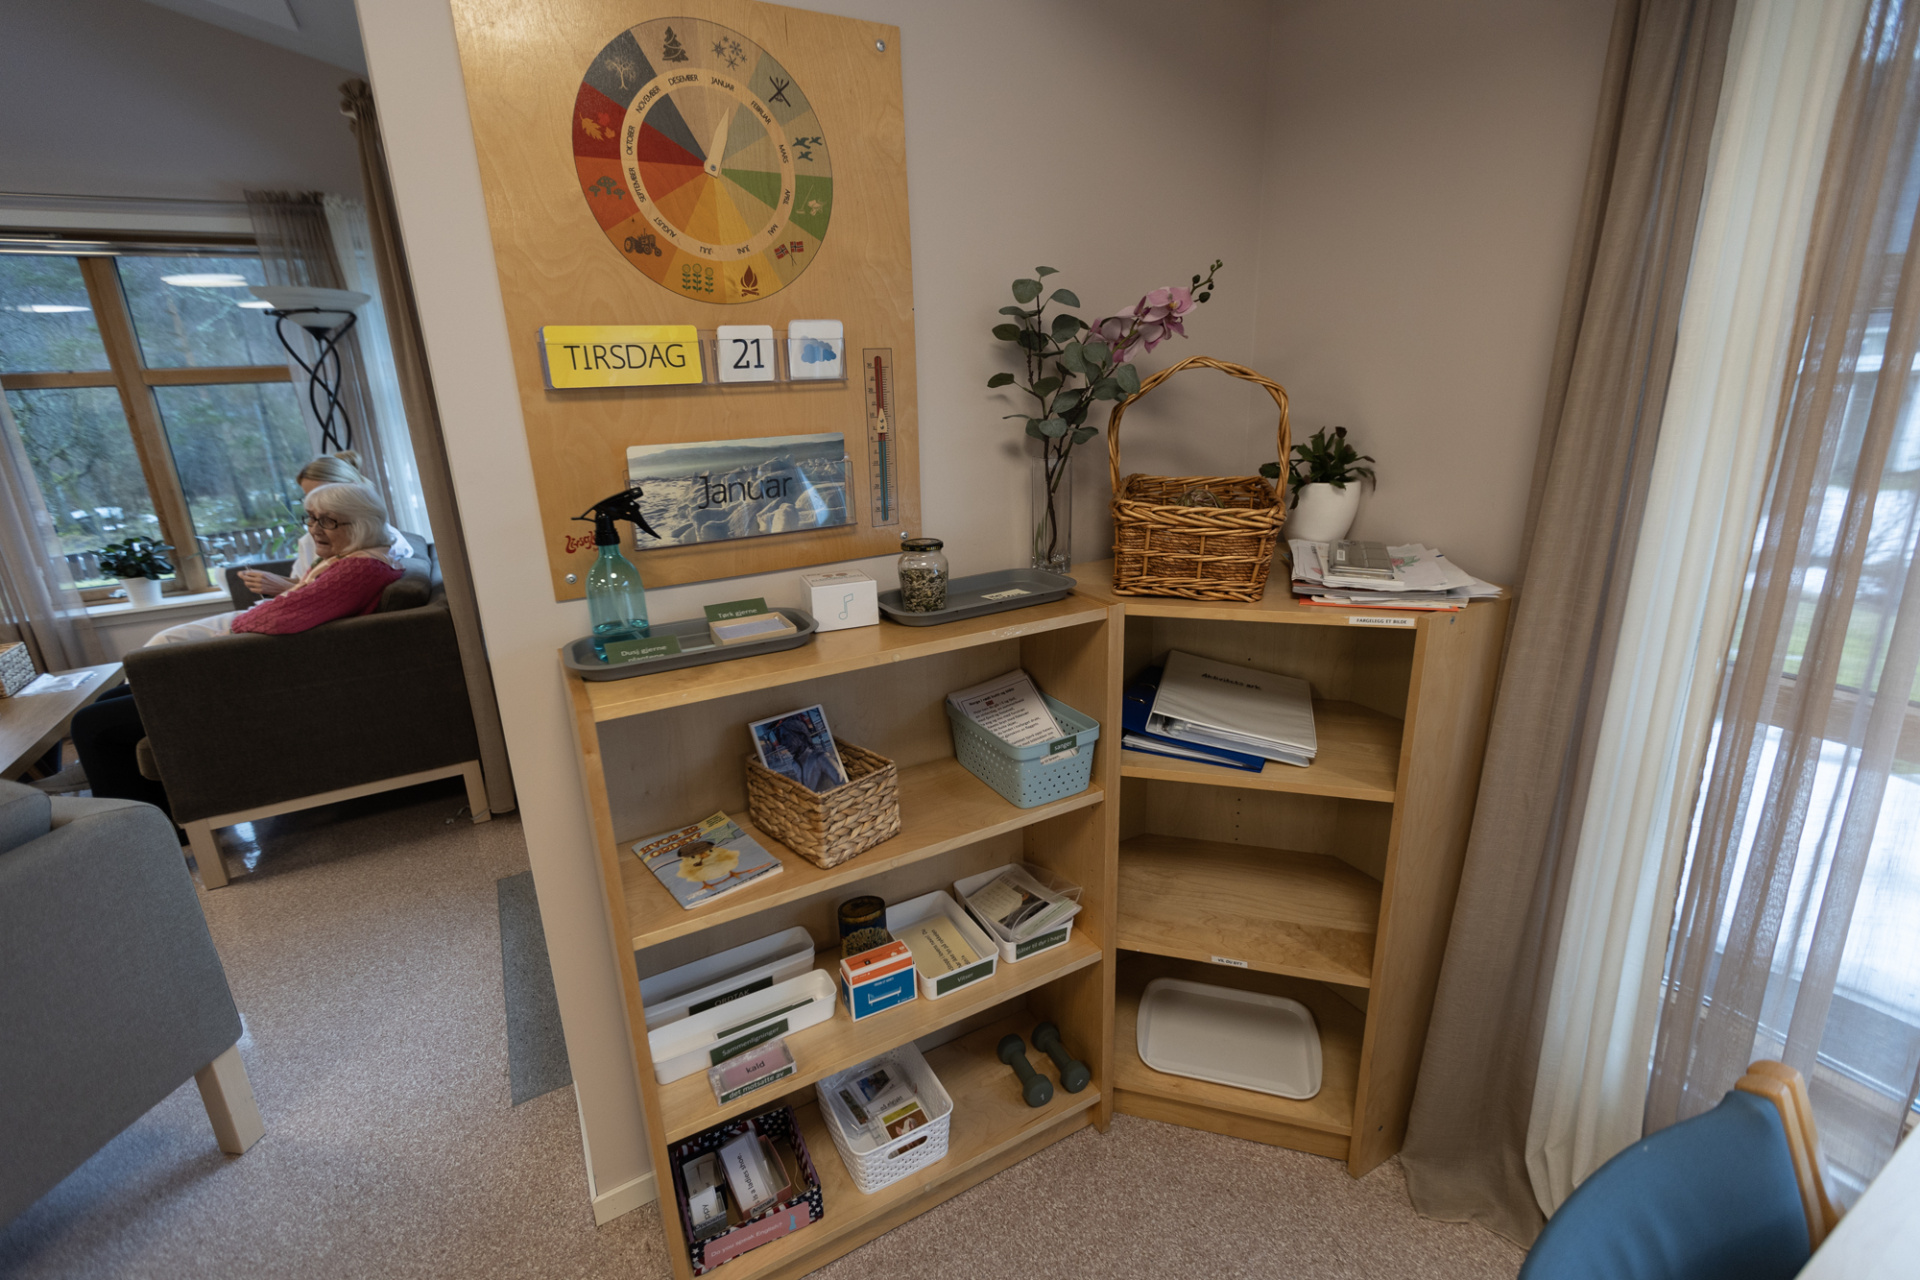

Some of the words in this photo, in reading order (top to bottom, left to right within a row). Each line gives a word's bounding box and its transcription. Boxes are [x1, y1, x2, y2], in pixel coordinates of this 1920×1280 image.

[668, 74, 698, 86] DESEMBER
[711, 76, 734, 91] JANUAR
[636, 86, 661, 113] NOVEMBER
[750, 100, 771, 125] FEBRUAR
[626, 125, 636, 155] OKTOBER
[779, 144, 789, 164] MARS
[628, 167, 646, 202] SEPTEMBER
[782, 188, 790, 204] APRIL
[653, 217, 677, 238] AUGUST
[768, 224, 778, 236] MAI
[564, 344, 686, 370] TIRSDAG
[732, 338, 764, 370] 21
[698, 475, 792, 509] Januar
[735, 608, 758, 617] gjerne
[641, 645, 667, 655] gjerne
[1054, 741, 1072, 751] sanger
[640, 833, 679, 854] HVOR
[722, 1027, 779, 1056] Sammenligninger
[746, 1061, 765, 1074] kald
[729, 1089, 741, 1099] det
[743, 1075, 774, 1093] motsatte
[743, 1170, 754, 1190] ladies
[702, 1204, 710, 1220] ppy
[752, 1198, 775, 1213] Animals
[722, 1244, 734, 1253] you
[736, 1235, 754, 1246] speak
[756, 1222, 783, 1236] English?
